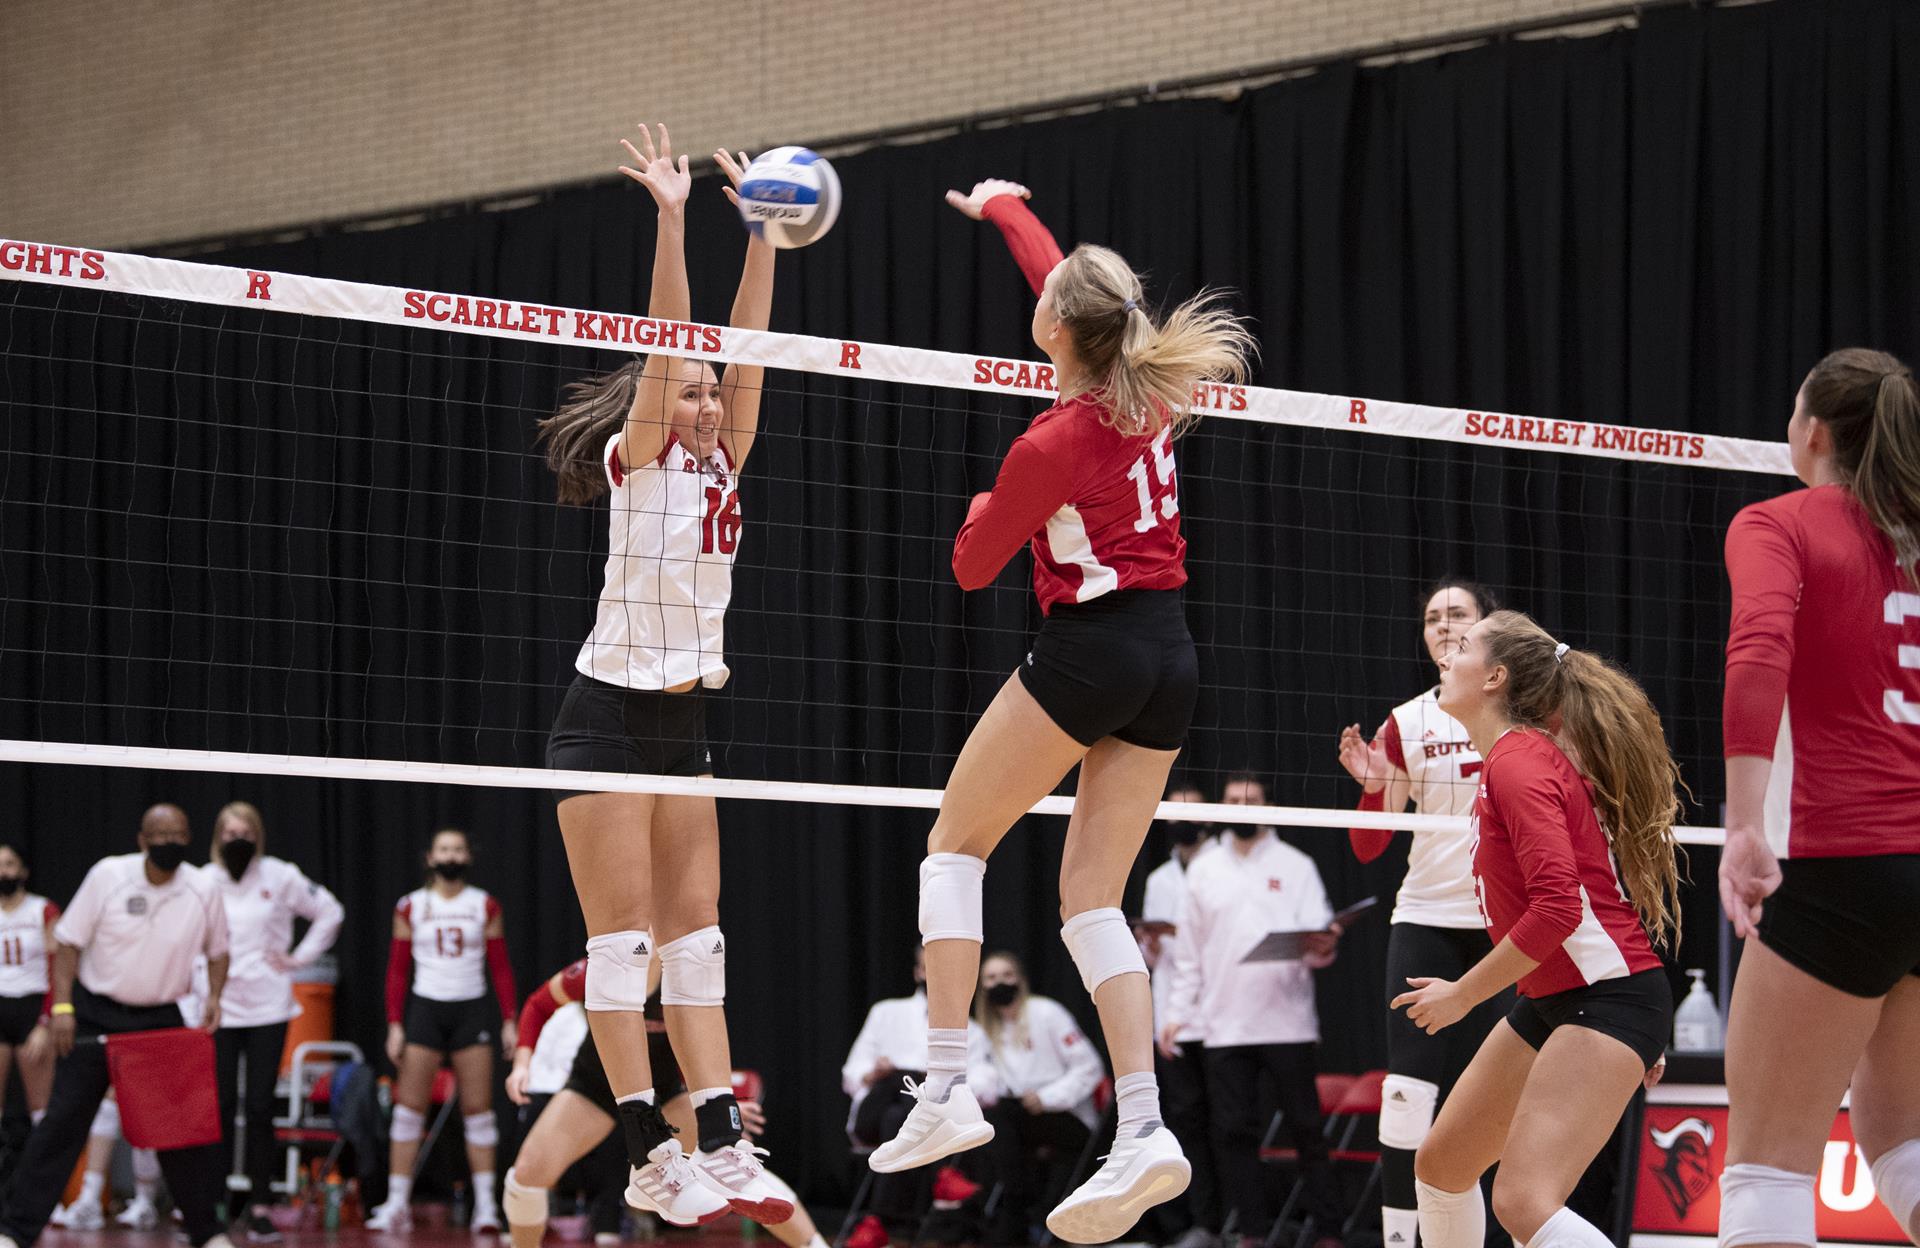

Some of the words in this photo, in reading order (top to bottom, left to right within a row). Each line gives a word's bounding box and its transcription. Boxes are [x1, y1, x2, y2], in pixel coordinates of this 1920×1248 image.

[246, 270, 271, 300] R
[404, 291, 566, 336] SCARLET
[574, 311, 722, 353] KNIGHTS
[839, 342, 862, 370] R
[1348, 399, 1367, 424] R
[1465, 413, 1586, 447] SCARLET
[1592, 425, 1704, 458] KNIGHTS
[701, 486, 742, 554] 16
[3, 936, 23, 966] 11
[436, 927, 463, 958] 13
